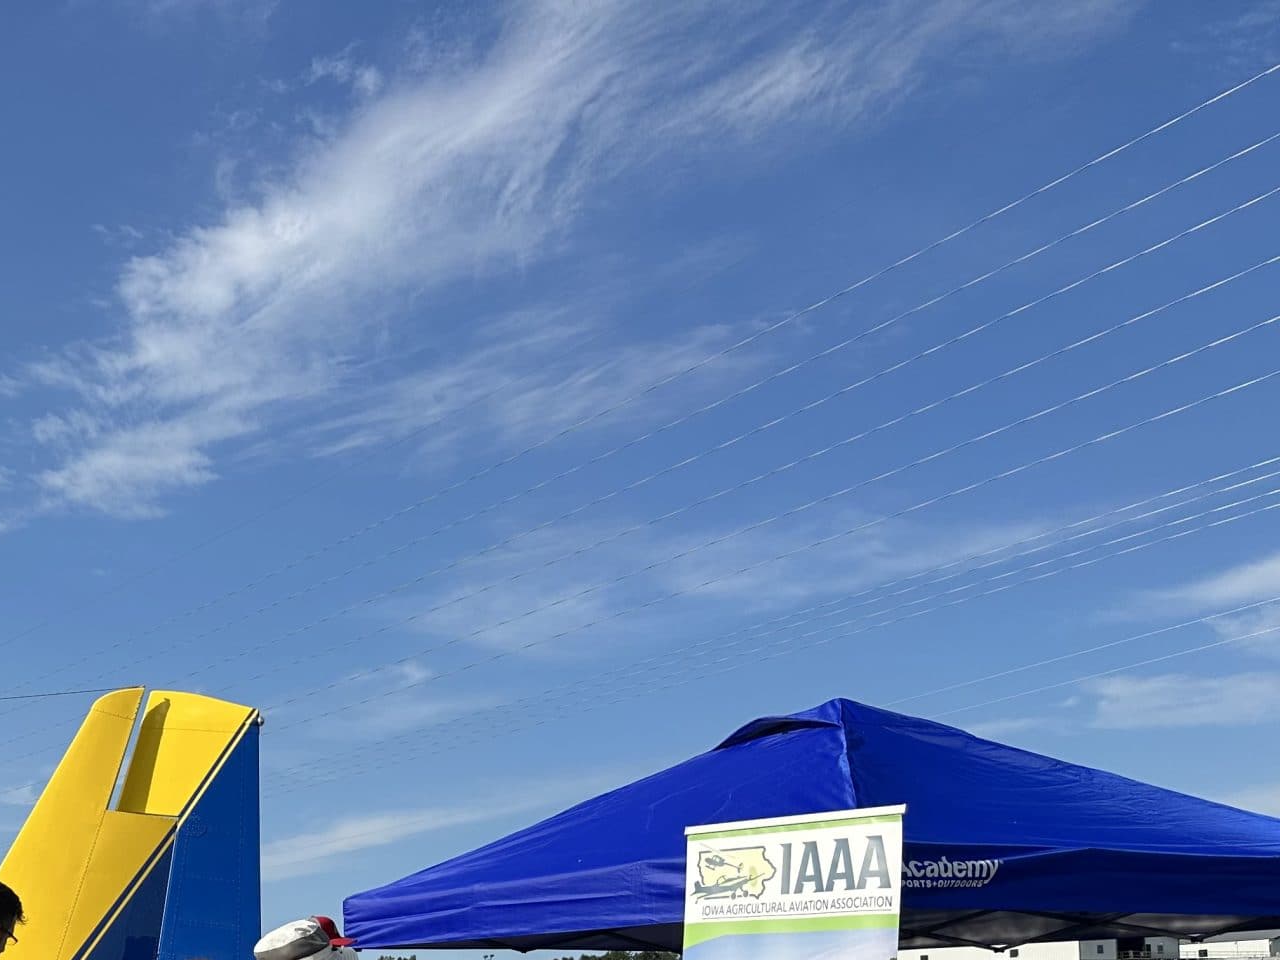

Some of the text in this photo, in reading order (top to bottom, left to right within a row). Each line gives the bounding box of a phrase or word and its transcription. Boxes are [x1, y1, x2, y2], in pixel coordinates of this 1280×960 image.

[780, 835, 892, 894] IAAA
[901, 879, 983, 888] PORTS+OUTDOORS
[702, 896, 893, 916] IOWA AGRICULTURAL AVIATION ASSOCIATION
